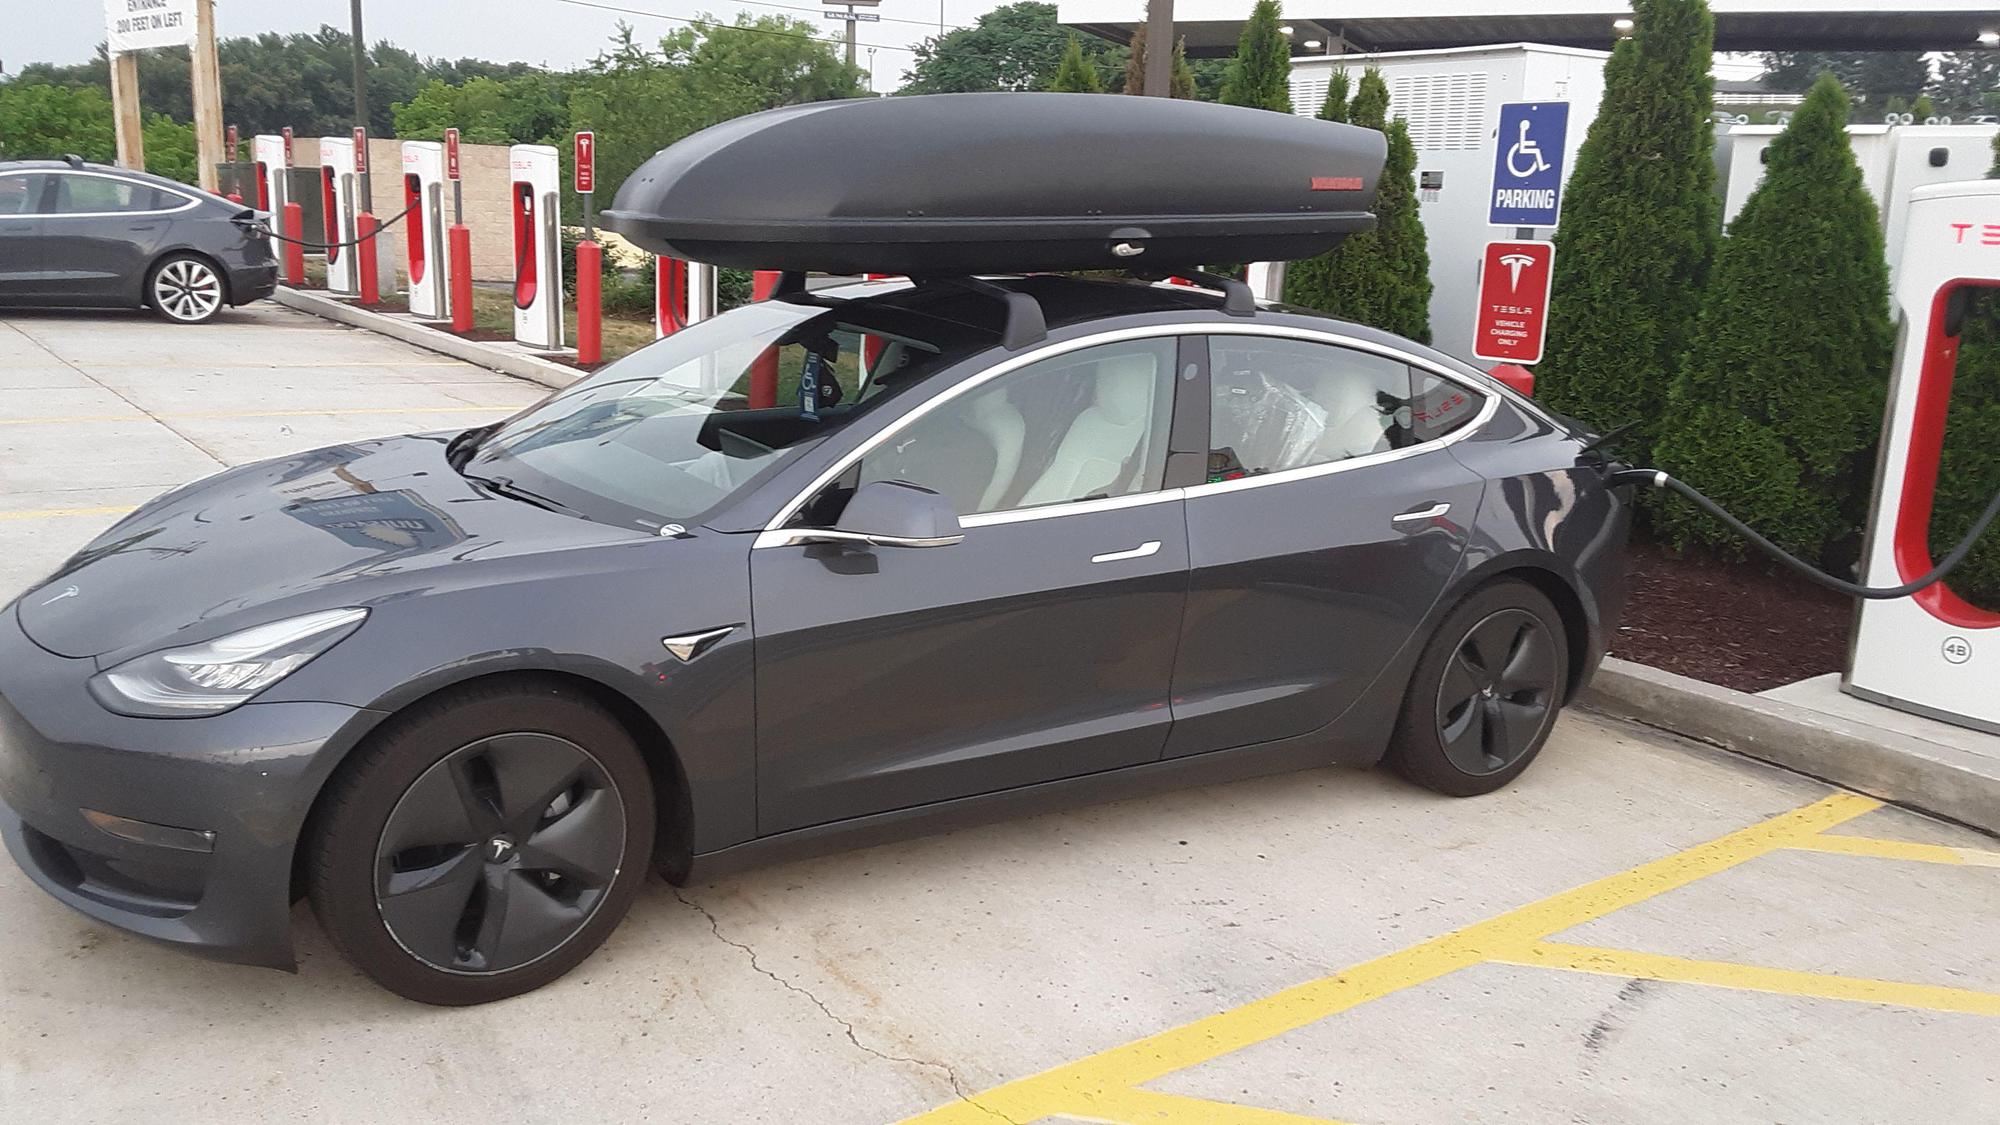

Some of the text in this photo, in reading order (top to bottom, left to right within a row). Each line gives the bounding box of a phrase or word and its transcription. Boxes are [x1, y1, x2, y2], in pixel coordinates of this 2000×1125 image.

[132, 16, 149, 31] FEET
[164, 12, 182, 27] LEFT
[1495, 188, 1555, 209] PARKING
[1492, 305, 1533, 315] TESLA
[1495, 320, 1526, 328] VEHICLE
[1490, 328, 1528, 338] CHARGING
[1497, 338, 1518, 346] ONLY
[1946, 644, 1966, 656] 4B
